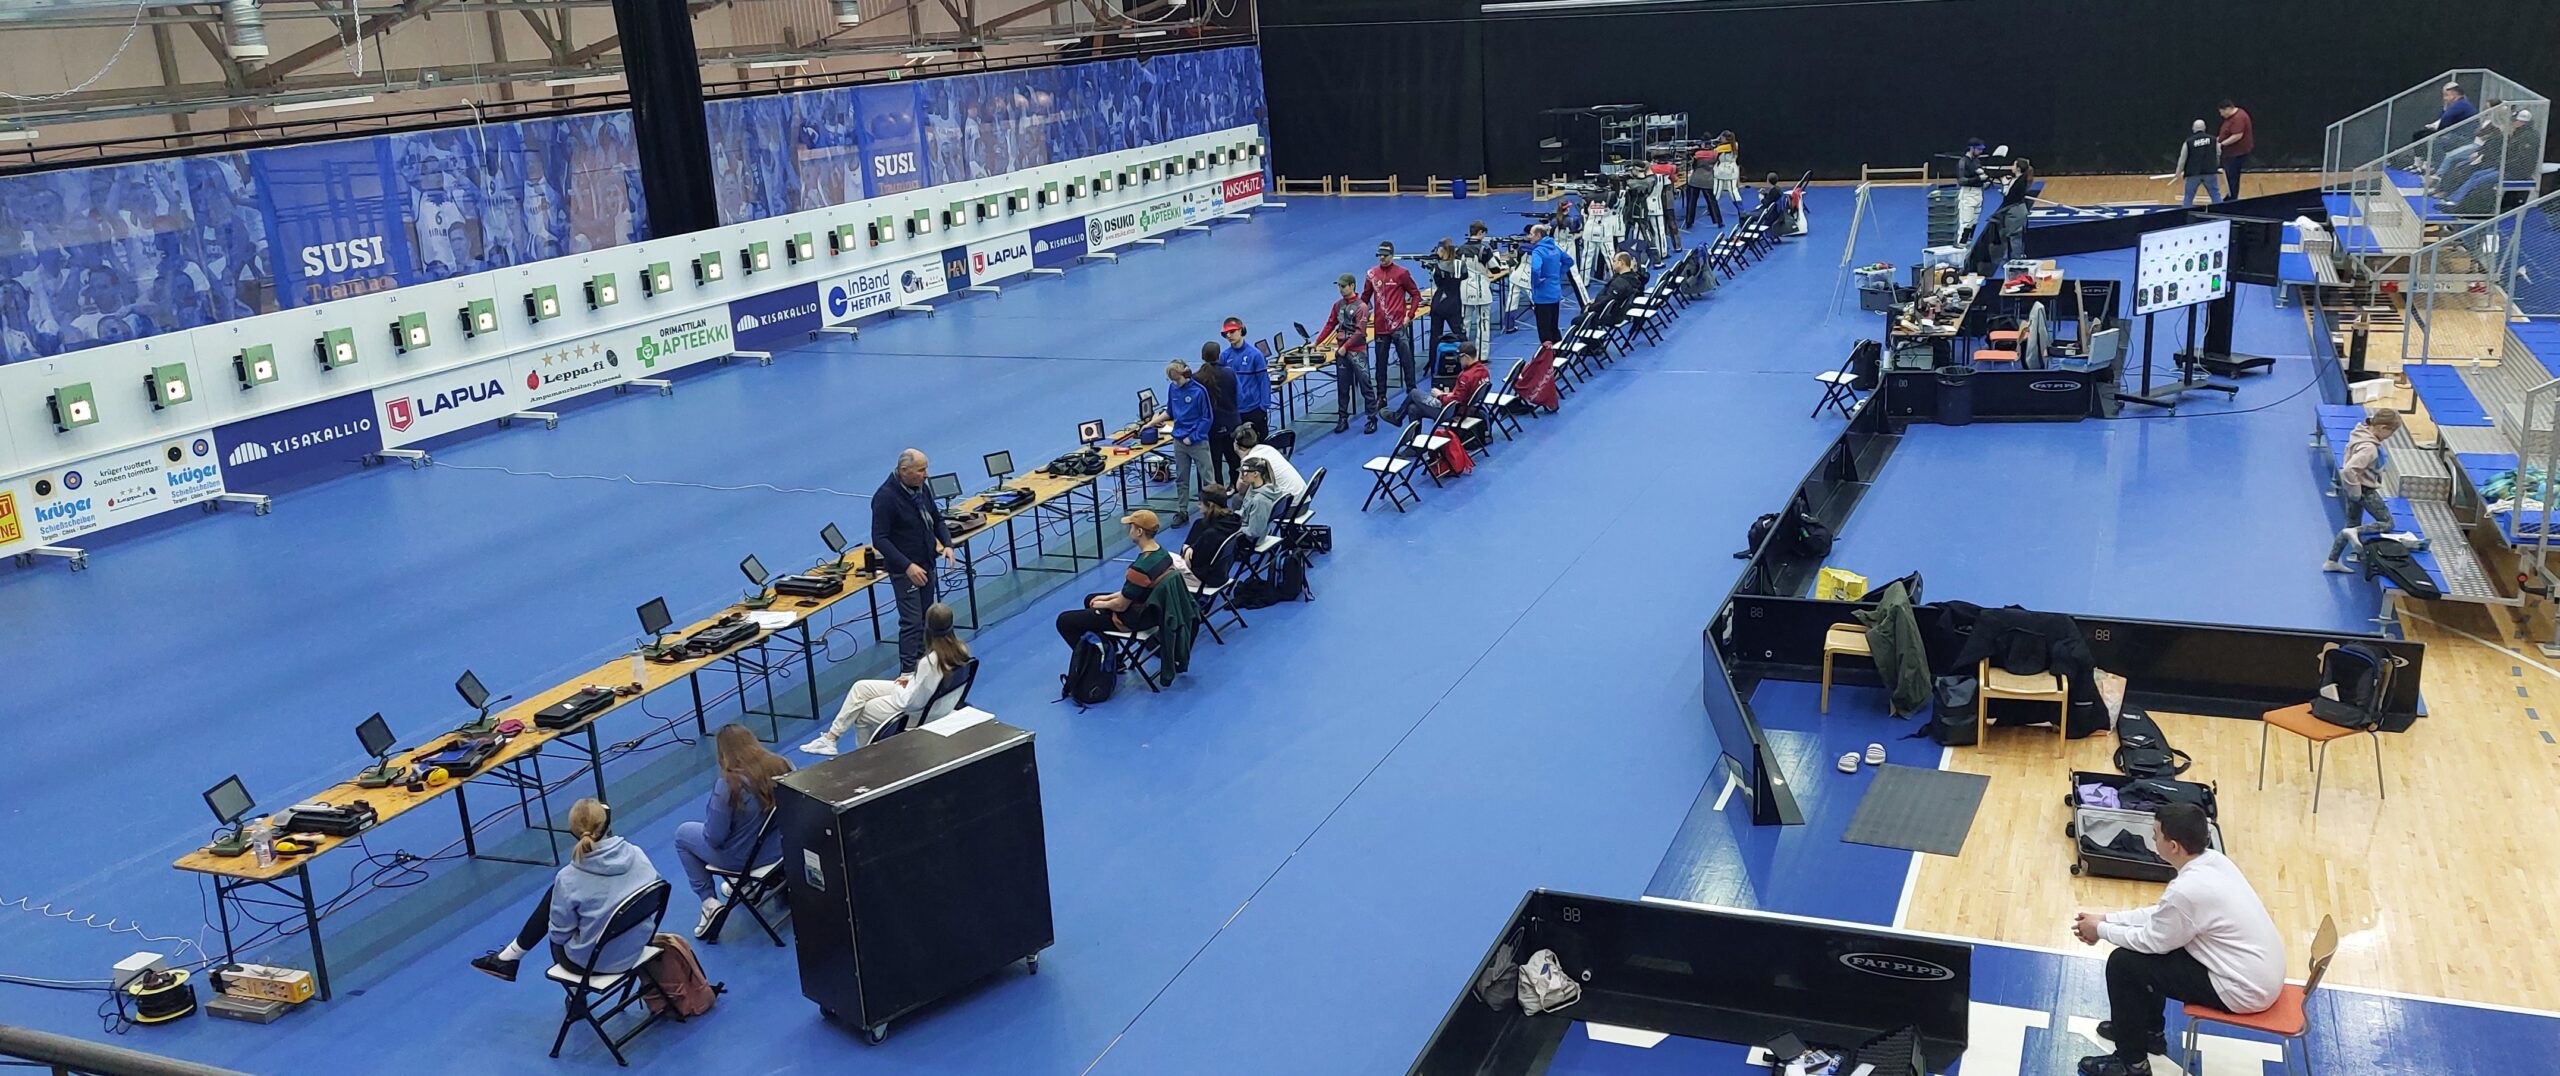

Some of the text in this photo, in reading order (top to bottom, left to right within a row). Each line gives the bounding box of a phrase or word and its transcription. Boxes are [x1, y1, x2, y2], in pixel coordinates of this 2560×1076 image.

[874, 152, 916, 177] SUSI
[435, 211, 442, 224] 6
[1104, 214, 1134, 232] OSUKO
[1150, 208, 1182, 224] APTEEKKI
[1050, 232, 1084, 250] KISAKALLIO
[302, 236, 384, 278] SUSI
[987, 244, 1027, 266] LAPUA
[848, 270, 890, 295] InBand
[851, 292, 891, 312] HERTAR
[760, 303, 816, 325] KISAKALLIO
[660, 319, 706, 337] ORIMATTILAN
[662, 324, 728, 356] APTEEKKI
[544, 360, 604, 384] Leppa.fi
[417, 380, 504, 416] LAPUA
[271, 418, 370, 454] KISAKALLIO
[99, 459, 152, 478] krüger tuotteet
[167, 463, 217, 488] krüger
[93, 475, 126, 488] Suomeen
[35, 497, 92, 523] krüger
[1852, 957, 1944, 976] FAT PIPE
